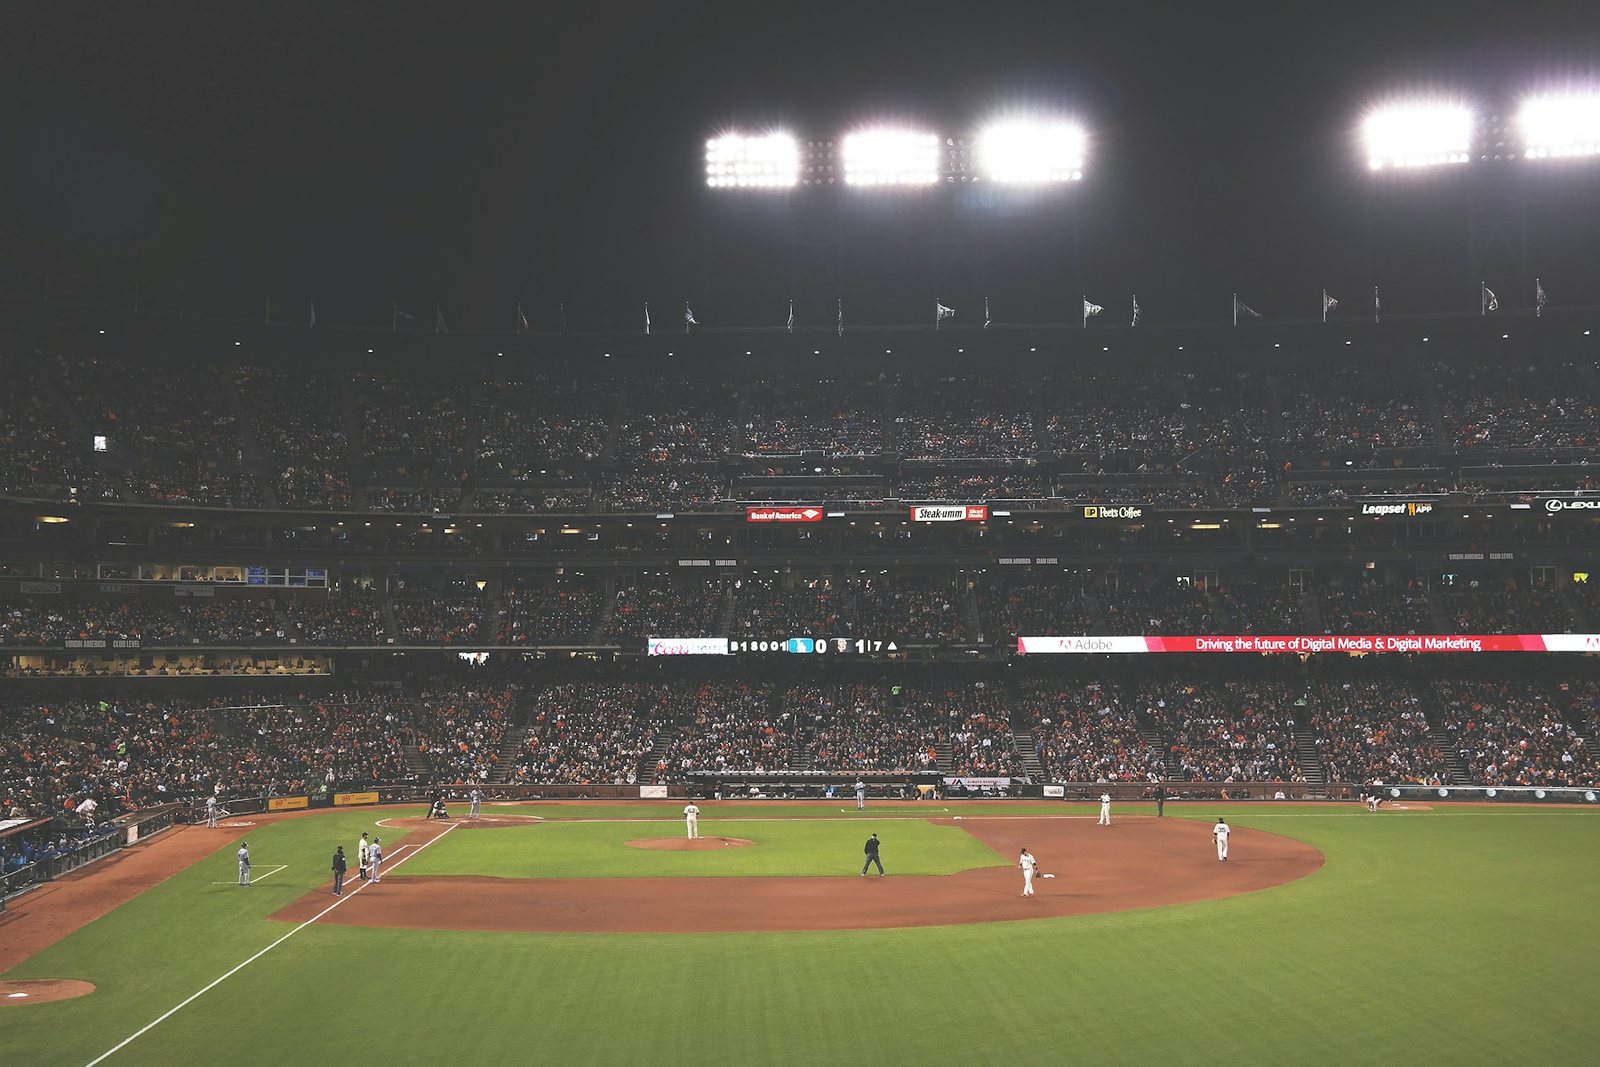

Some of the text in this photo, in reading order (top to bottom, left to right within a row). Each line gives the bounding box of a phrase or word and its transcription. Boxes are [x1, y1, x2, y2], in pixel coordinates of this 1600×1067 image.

[920, 508, 962, 518] Steak-umm
[1119, 507, 1141, 518] Coffee
[1362, 503, 1406, 515] Leapset
[83, 640, 106, 648] AMERICA
[113, 640, 125, 648] CLUB
[126, 640, 140, 648] LEVEL
[815, 639, 827, 653] 0
[855, 639, 864, 653] 1
[874, 641, 882, 651] 7
[1075, 639, 1113, 650] Adobe
[1196, 637, 1481, 652] Driving the future of Digital Media & Digital Marketing
